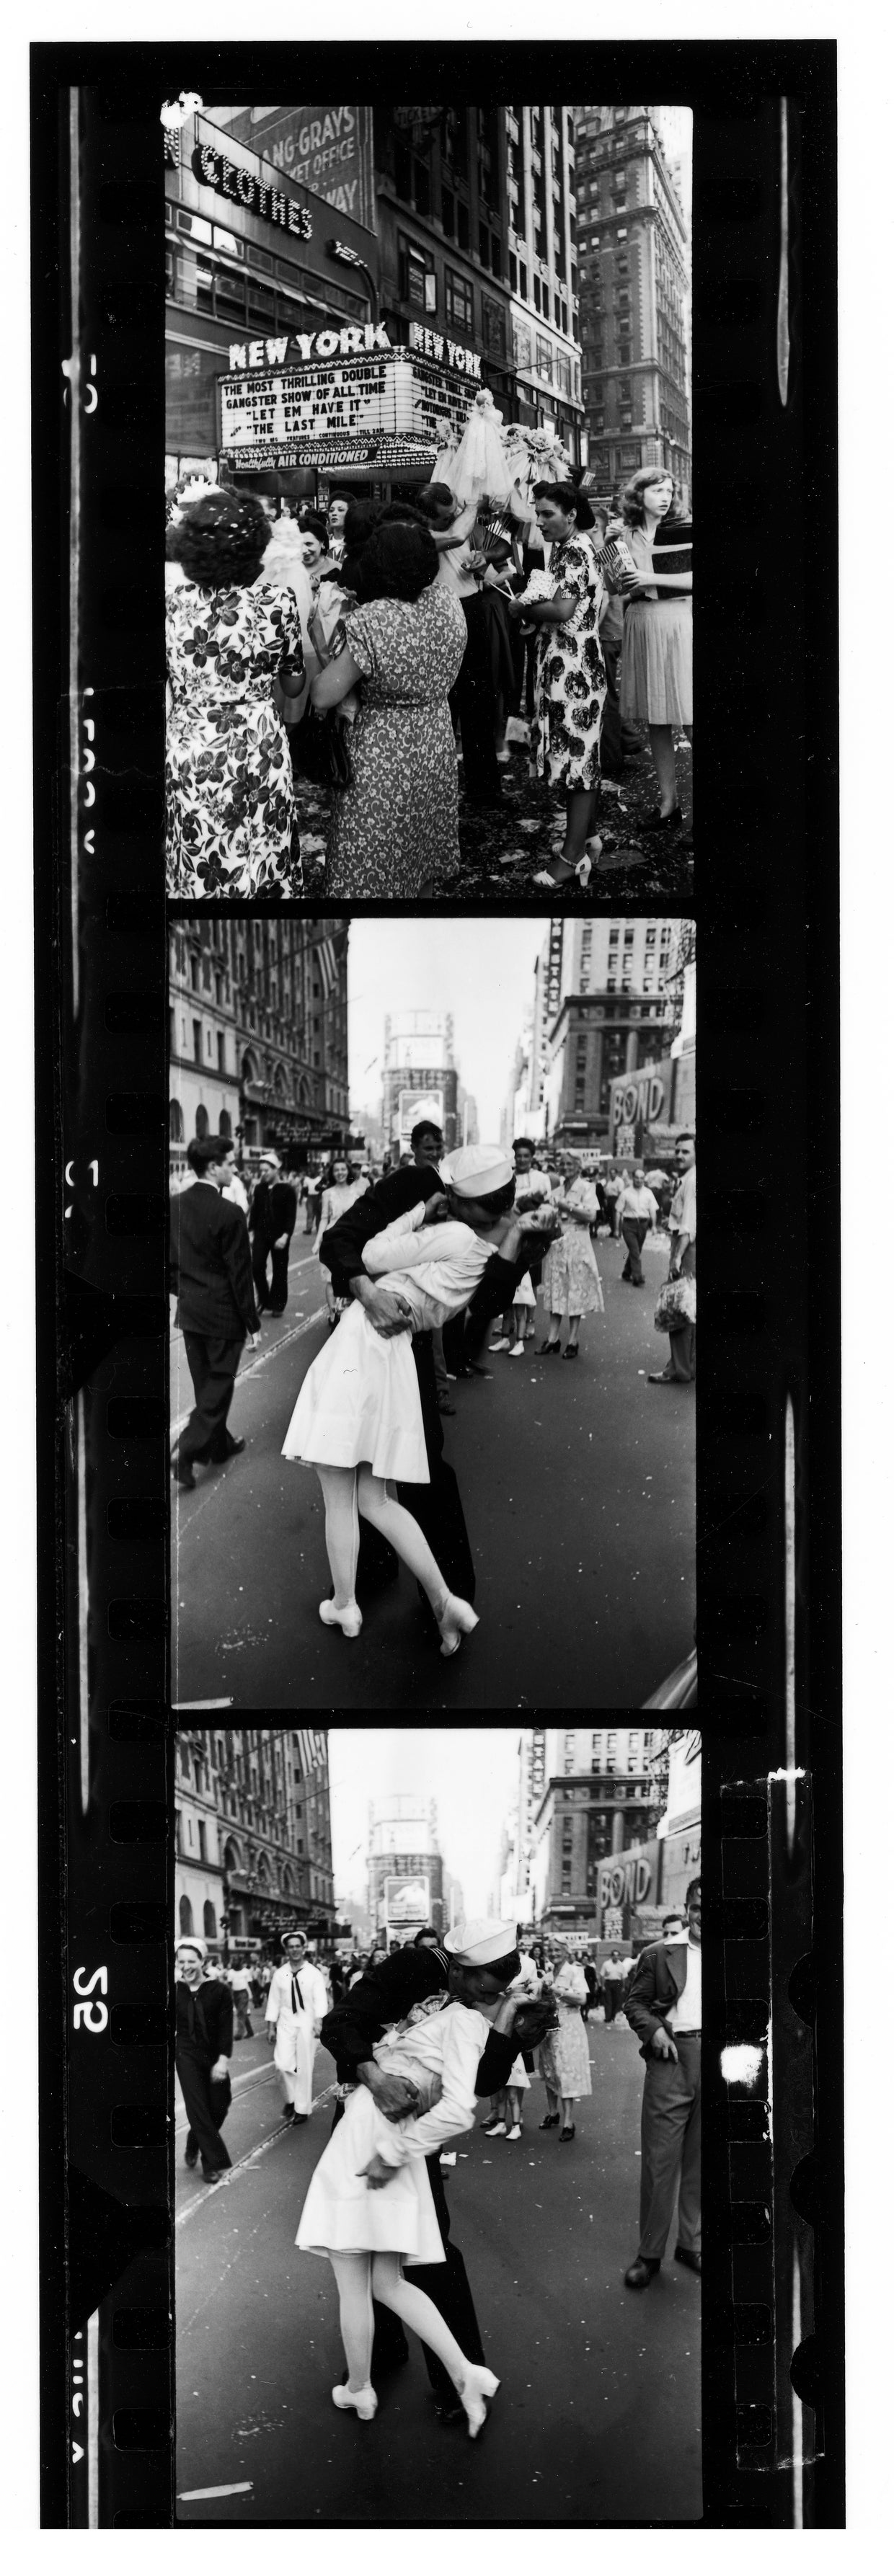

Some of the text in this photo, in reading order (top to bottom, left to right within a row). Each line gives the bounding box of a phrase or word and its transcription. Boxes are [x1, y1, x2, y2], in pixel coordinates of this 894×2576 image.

[313, 136, 355, 175] OFFICE
[200, 145, 313, 239] CLOTHES
[229, 321, 391, 370] NEW YORK
[414, 322, 482, 379] NEW YORK
[224, 365, 386, 396] THE MOST THRILLING DOUBLE
[226, 381, 386, 409] GANGSTER SHOW OF ALL TIME
[284, 405, 301, 417] EM
[312, 401, 344, 415] HAVE
[285, 418, 316, 432] LAST
[234, 449, 368, 471] Healthfully AIR CONDITIONED
[613, 1078, 664, 1125] BOND
[601, 1859, 651, 1909] BOND
